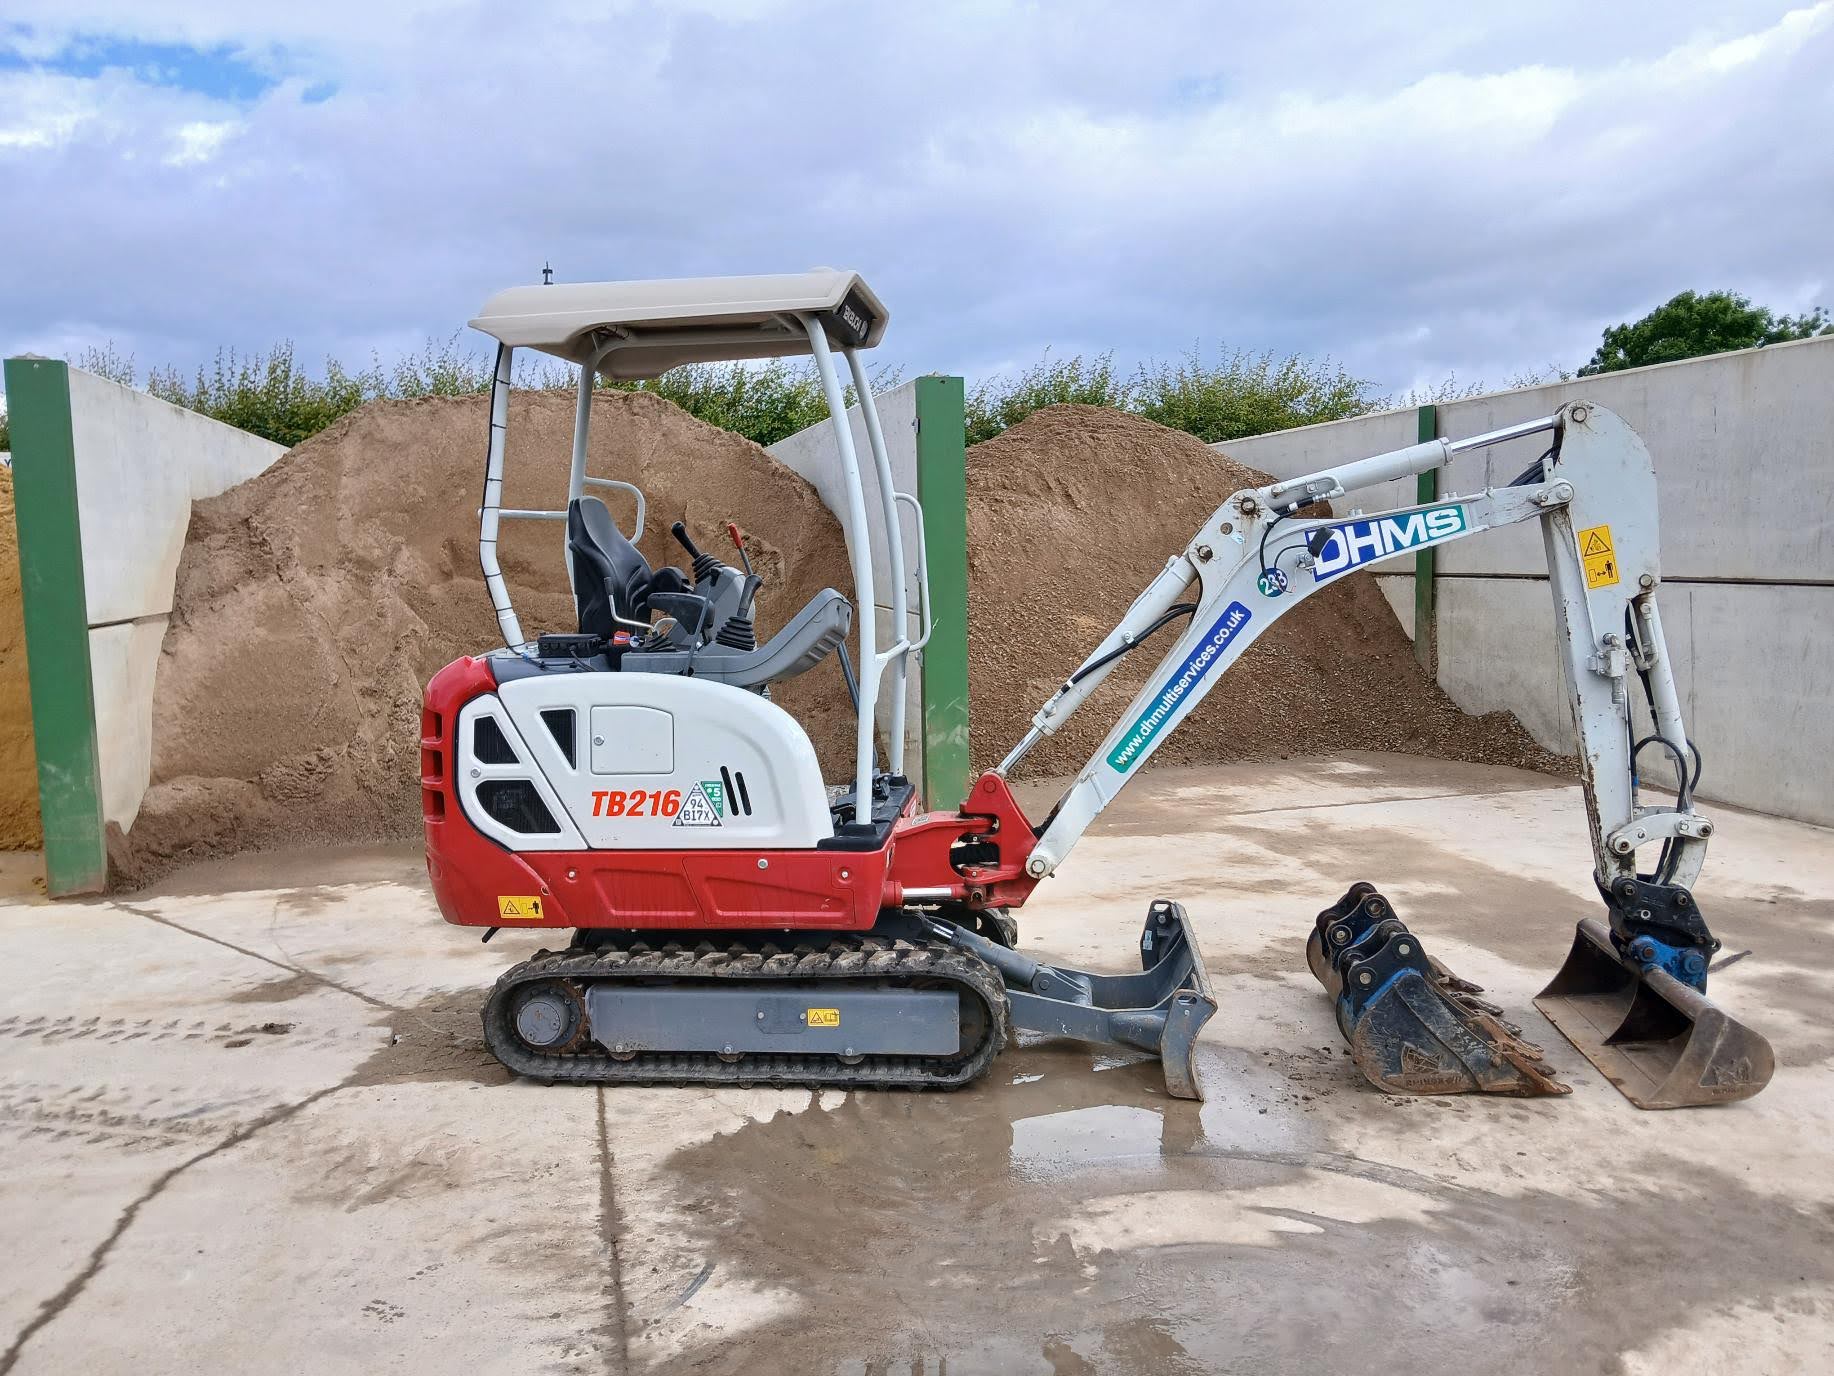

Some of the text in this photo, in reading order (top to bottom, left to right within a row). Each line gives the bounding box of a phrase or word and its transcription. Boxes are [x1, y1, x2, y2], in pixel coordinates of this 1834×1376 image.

[1308, 508, 1462, 577] DHMS
[1115, 609, 1245, 766] www.dhmultiservices.co.uk
[591, 789, 681, 817] TB216
[690, 798, 704, 809] 94
[713, 787, 721, 797] 5
